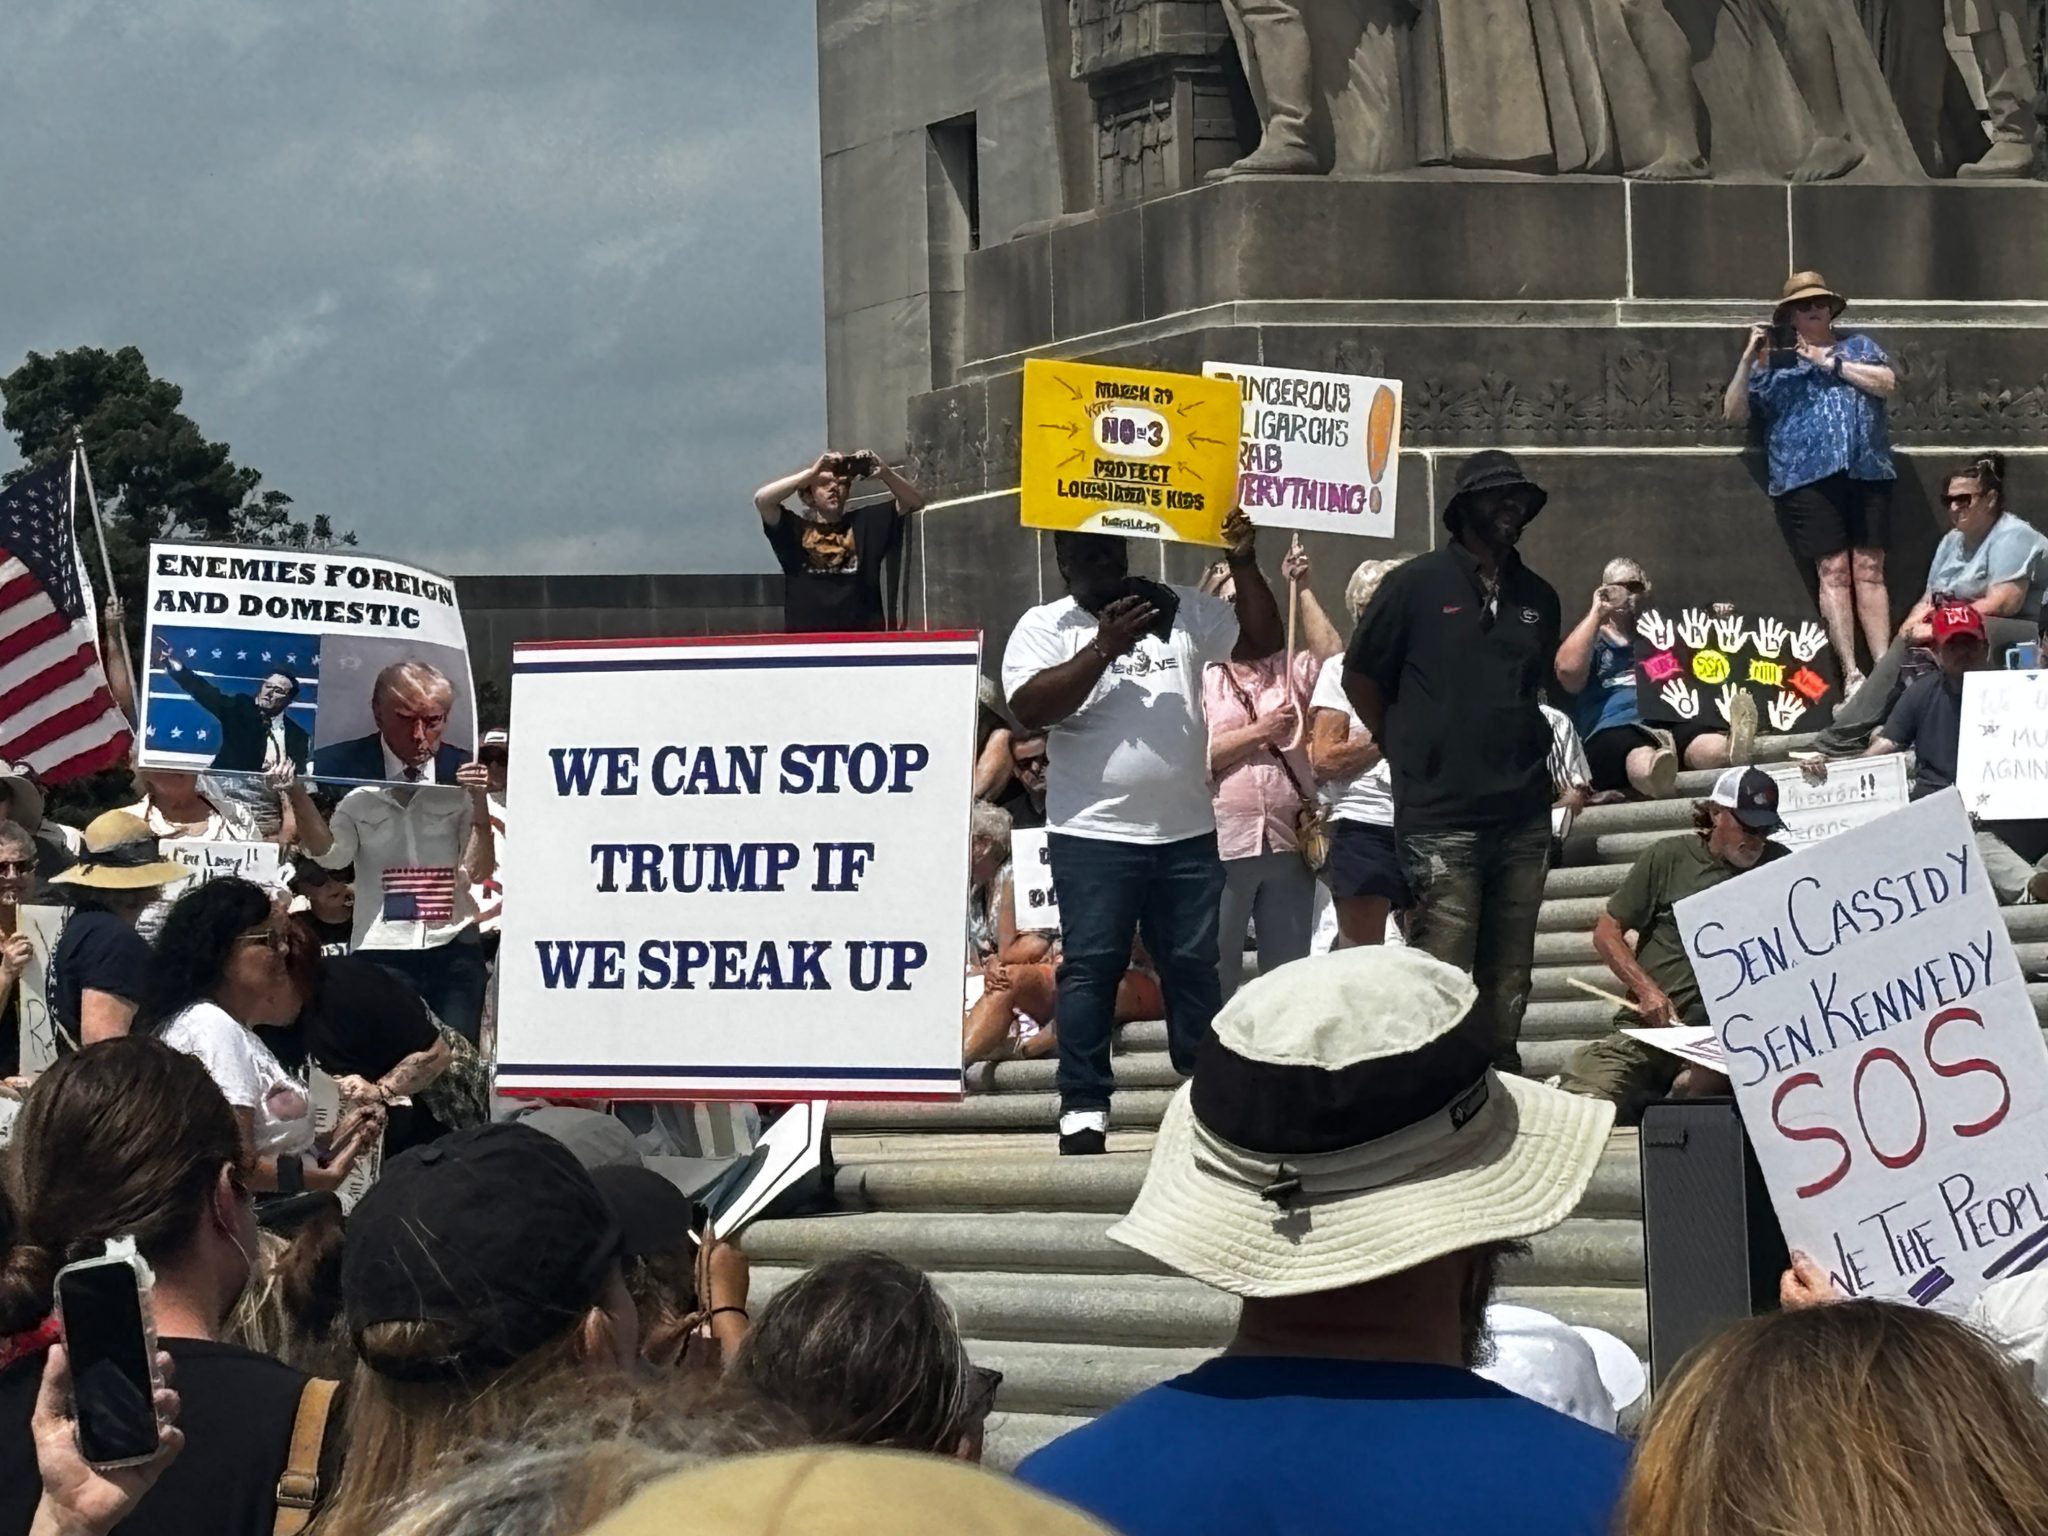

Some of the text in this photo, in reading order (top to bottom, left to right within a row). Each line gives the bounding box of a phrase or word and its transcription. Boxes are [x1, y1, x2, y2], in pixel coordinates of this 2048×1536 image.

[1095, 380, 1150, 402] MARCH
[1214, 372, 1350, 413] ANGEROUS
[1101, 416, 1135, 445] NO
[1147, 421, 1164, 447] 3
[1240, 405, 1349, 447] LIGARCHS
[1093, 458, 1172, 483] PROTECT
[1239, 441, 1283, 473] RAB
[1057, 478, 1205, 511] LOUISIANA'S KIDS
[156, 554, 454, 607] ENEMIES FOREIGN
[153, 589, 421, 629] AND DOMESTIC
[548, 742, 929, 797] WE CAN STOP
[590, 842, 875, 893] TRUMP IF
[1693, 843, 1971, 1002] SEN. CASSIDY
[535, 939, 929, 991] WE SPEAK UP
[1809, 929, 1995, 1050] KENNEDY
[1771, 1007, 2012, 1199] SOS
[1858, 1201, 1946, 1276] THE
[1938, 1173, 2048, 1252] PEOPL
